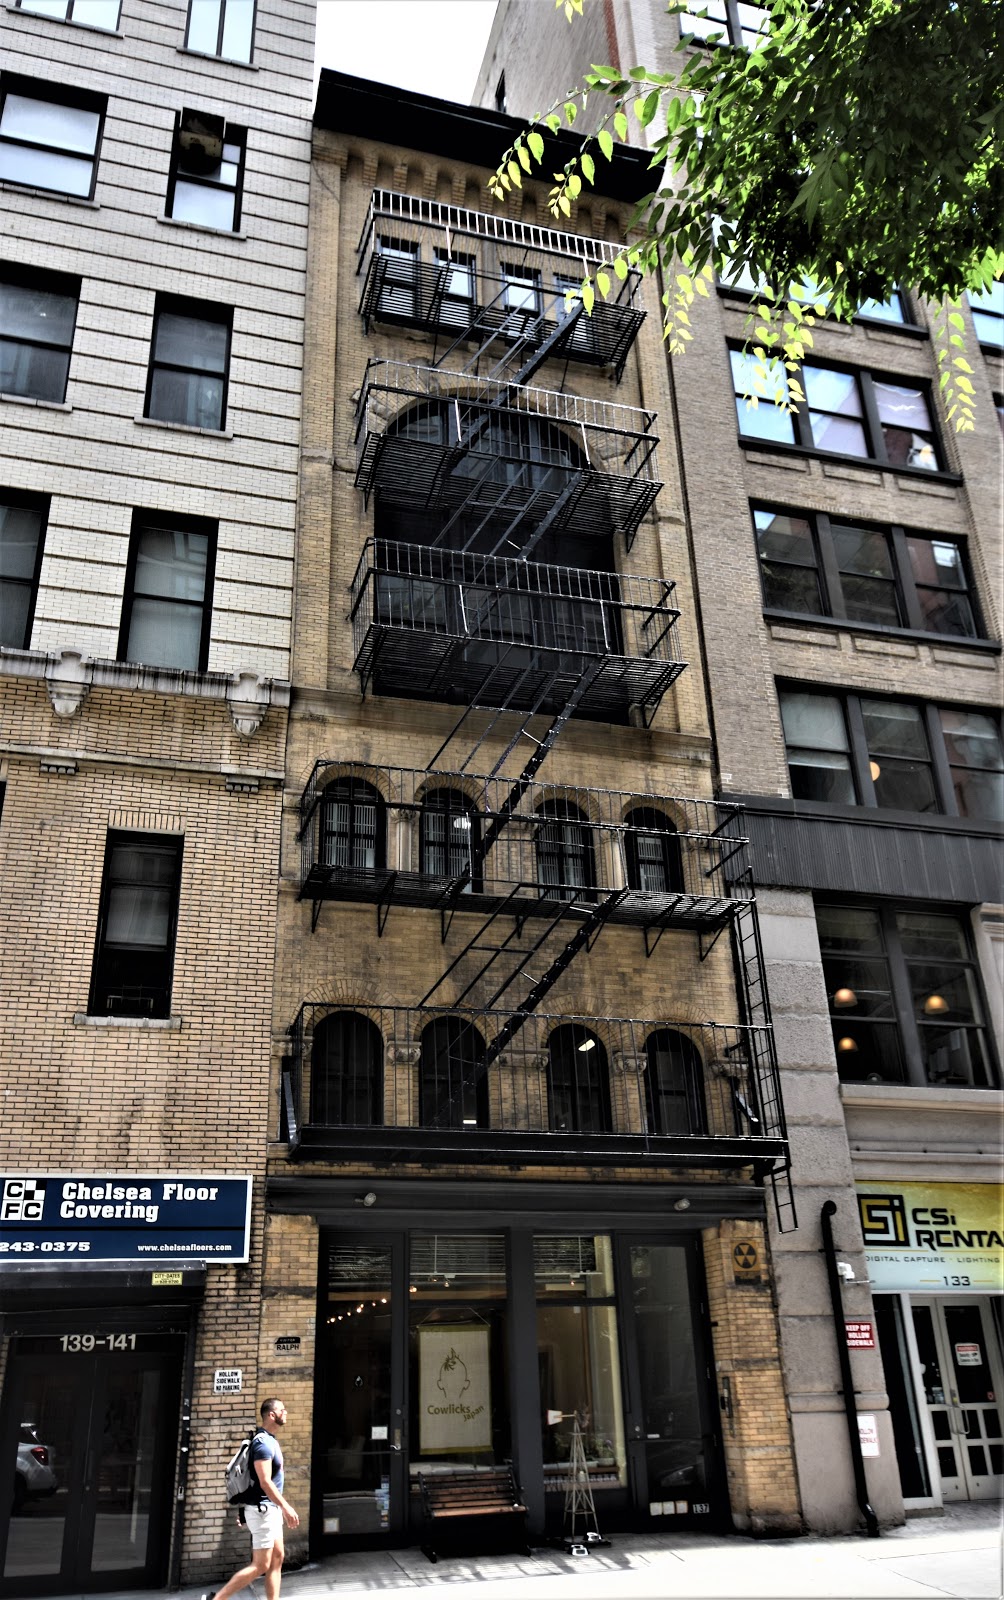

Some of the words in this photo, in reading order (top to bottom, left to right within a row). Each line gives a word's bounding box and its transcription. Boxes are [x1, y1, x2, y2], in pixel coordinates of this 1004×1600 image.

[62, 1182, 151, 1200] Chelsea
[162, 1183, 219, 1201] Floor
[60, 1201, 159, 1222] Covering
[0, 1241, 91, 1252] 243-0375
[137, 1243, 232, 1252] www.chelseafloors.com
[915, 1230, 1004, 1251] RENTA
[943, 1275, 971, 1286] 133
[59, 1334, 137, 1352] 139-141
[427, 1403, 471, 1415] Cowlicks
[463, 1405, 485, 1422] Japan
[694, 1503, 709, 1513] 137
